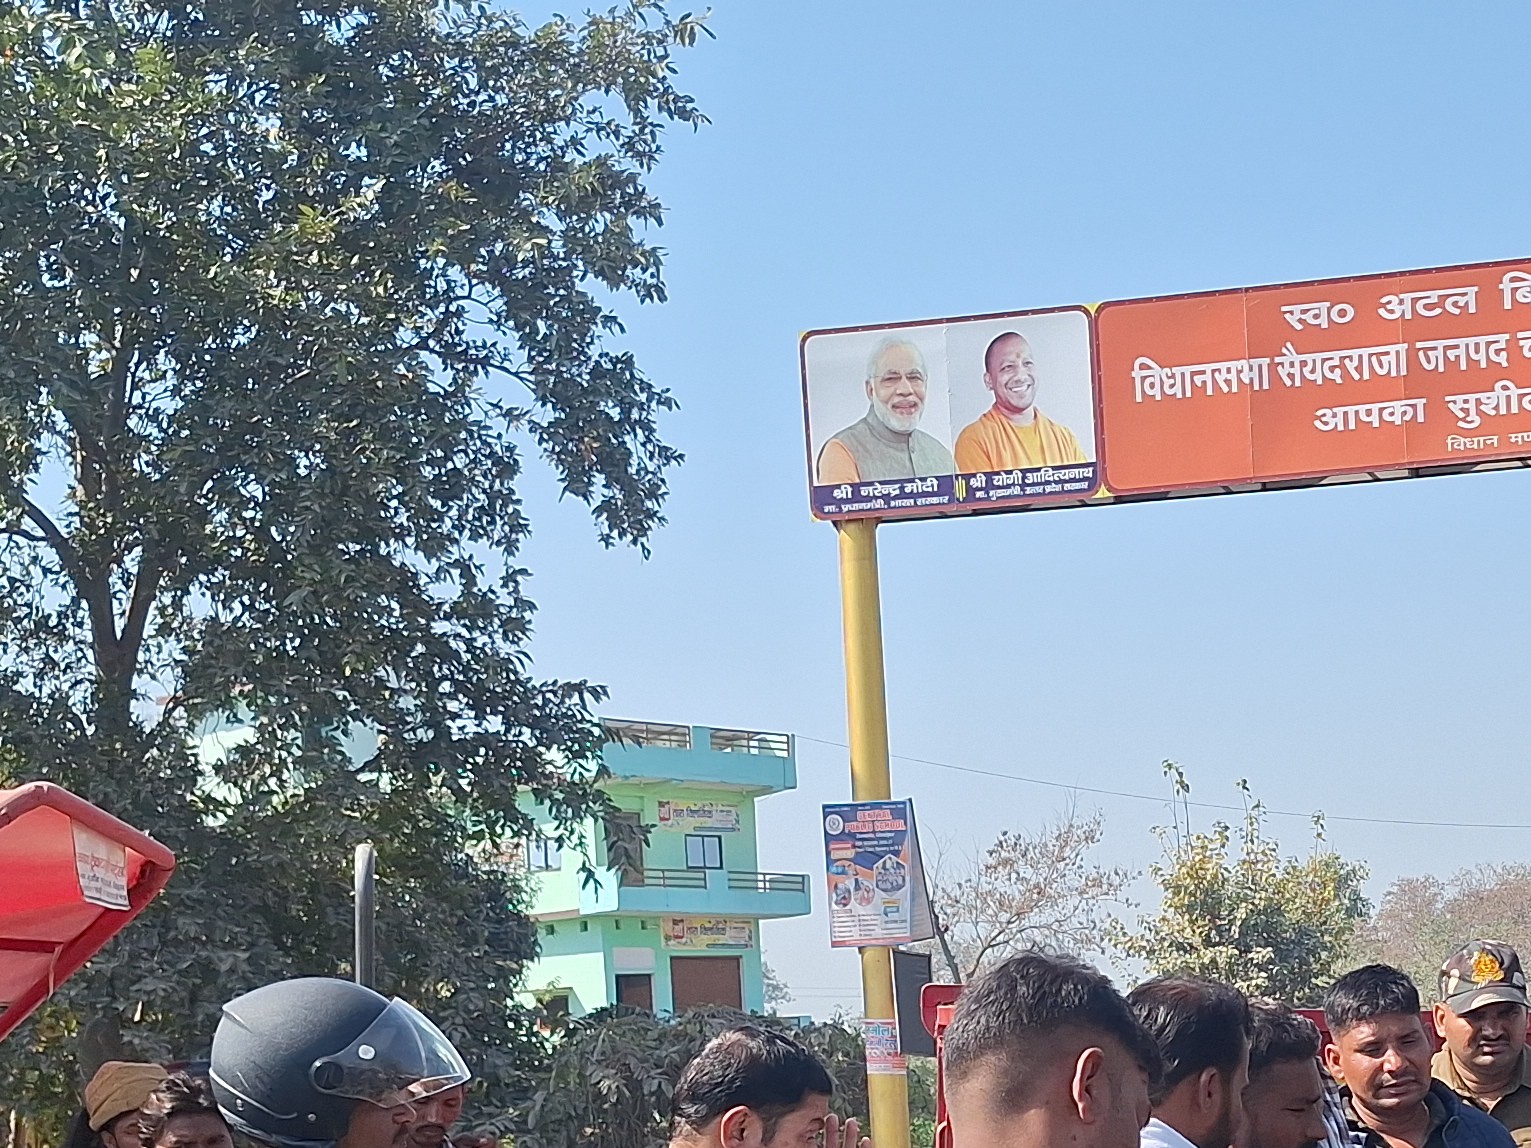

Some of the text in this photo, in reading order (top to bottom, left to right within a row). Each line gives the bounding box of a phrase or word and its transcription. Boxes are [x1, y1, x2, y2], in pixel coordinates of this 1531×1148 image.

[1281, 301, 1355, 331] स्व०
[1377, 286, 1479, 320] अटल
[1131, 356, 1270, 403] विधानसभा
[1274, 341, 1408, 388] सैयदराजा
[1415, 332, 1511, 373] जनपद
[1313, 397, 1427, 432] आपका
[1446, 434, 1499, 452] विधान
[832, 477, 940, 500] श्री नरेन्द्र मोदी
[969, 466, 1094, 489] श्री योगी आदित्यनाथ
